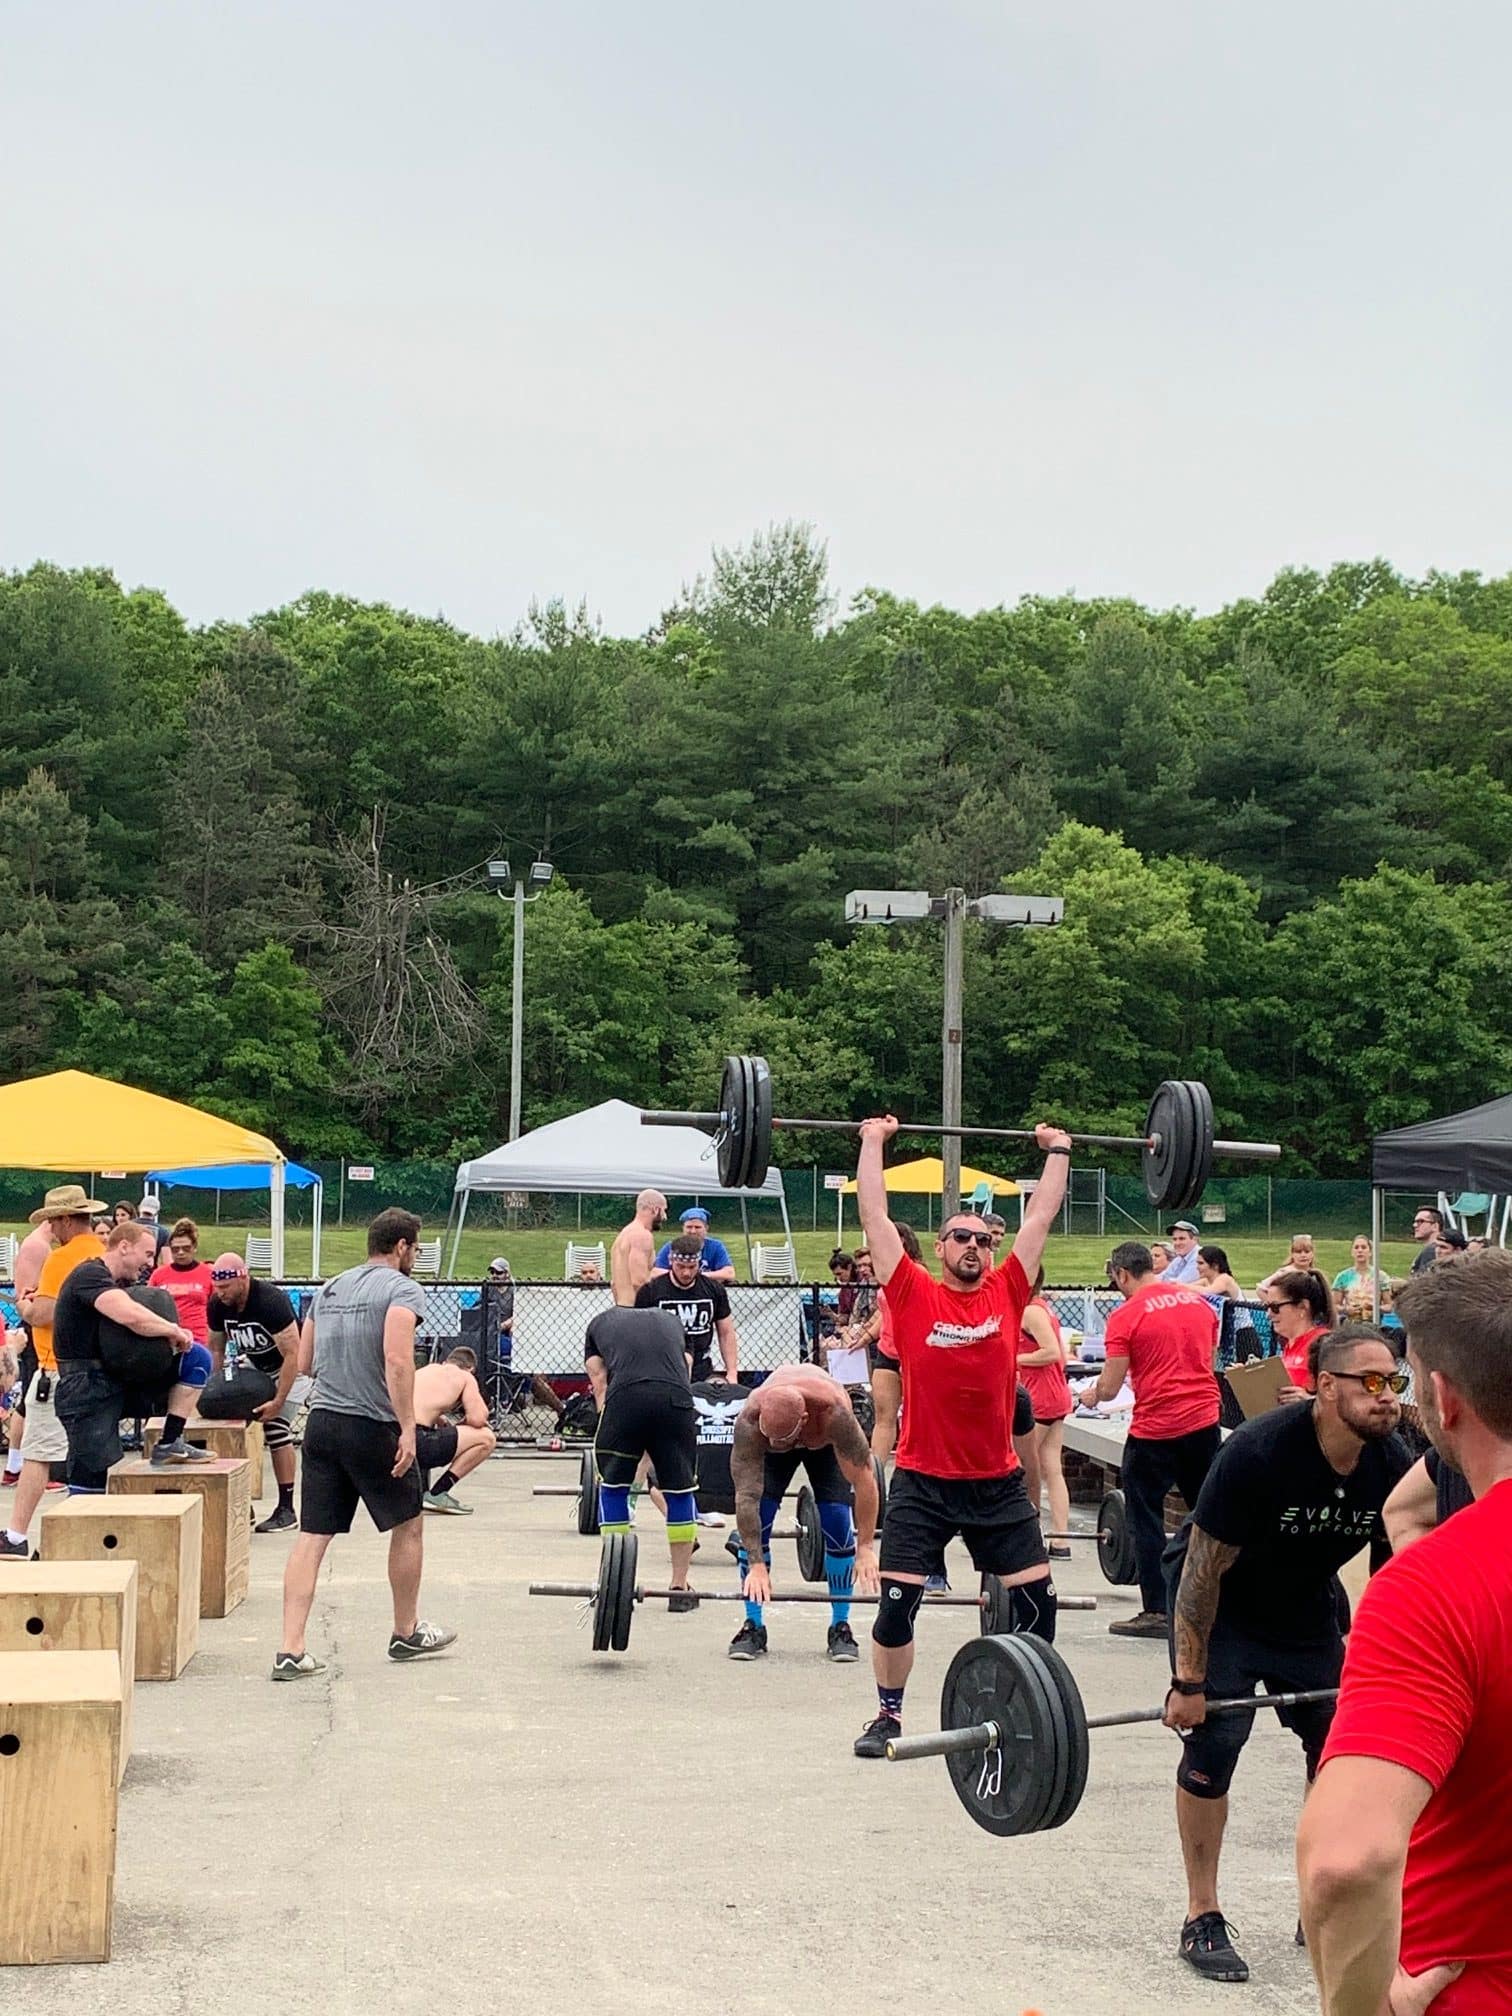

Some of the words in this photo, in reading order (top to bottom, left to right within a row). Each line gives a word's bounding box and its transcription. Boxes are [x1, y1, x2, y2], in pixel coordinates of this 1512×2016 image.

[1145, 1291, 1201, 1313] JUDGE
[1280, 1506, 1377, 1524] EVOLVE
[1280, 1523, 1300, 1534] TO
